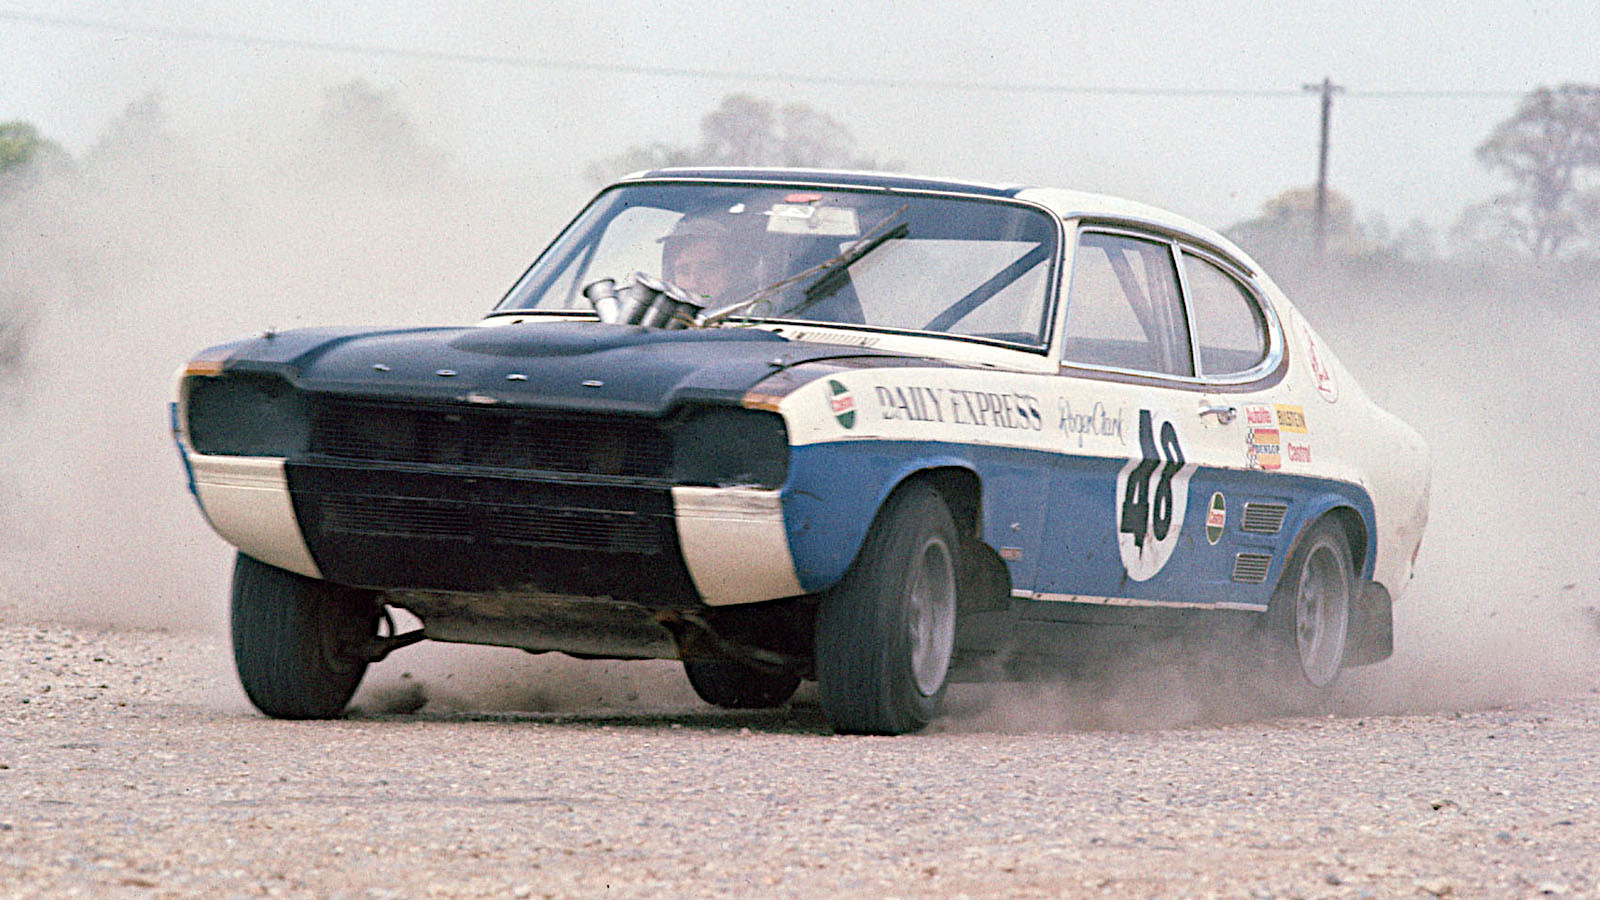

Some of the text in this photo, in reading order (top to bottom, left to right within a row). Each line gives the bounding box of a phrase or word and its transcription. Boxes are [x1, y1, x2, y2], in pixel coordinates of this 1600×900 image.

[875, 386, 1042, 432] DAILY EXPRESS
[1253, 444, 1280, 454] DUNLOP
[1287, 442, 1311, 463] Castrol
[1120, 409, 1186, 560] 48
